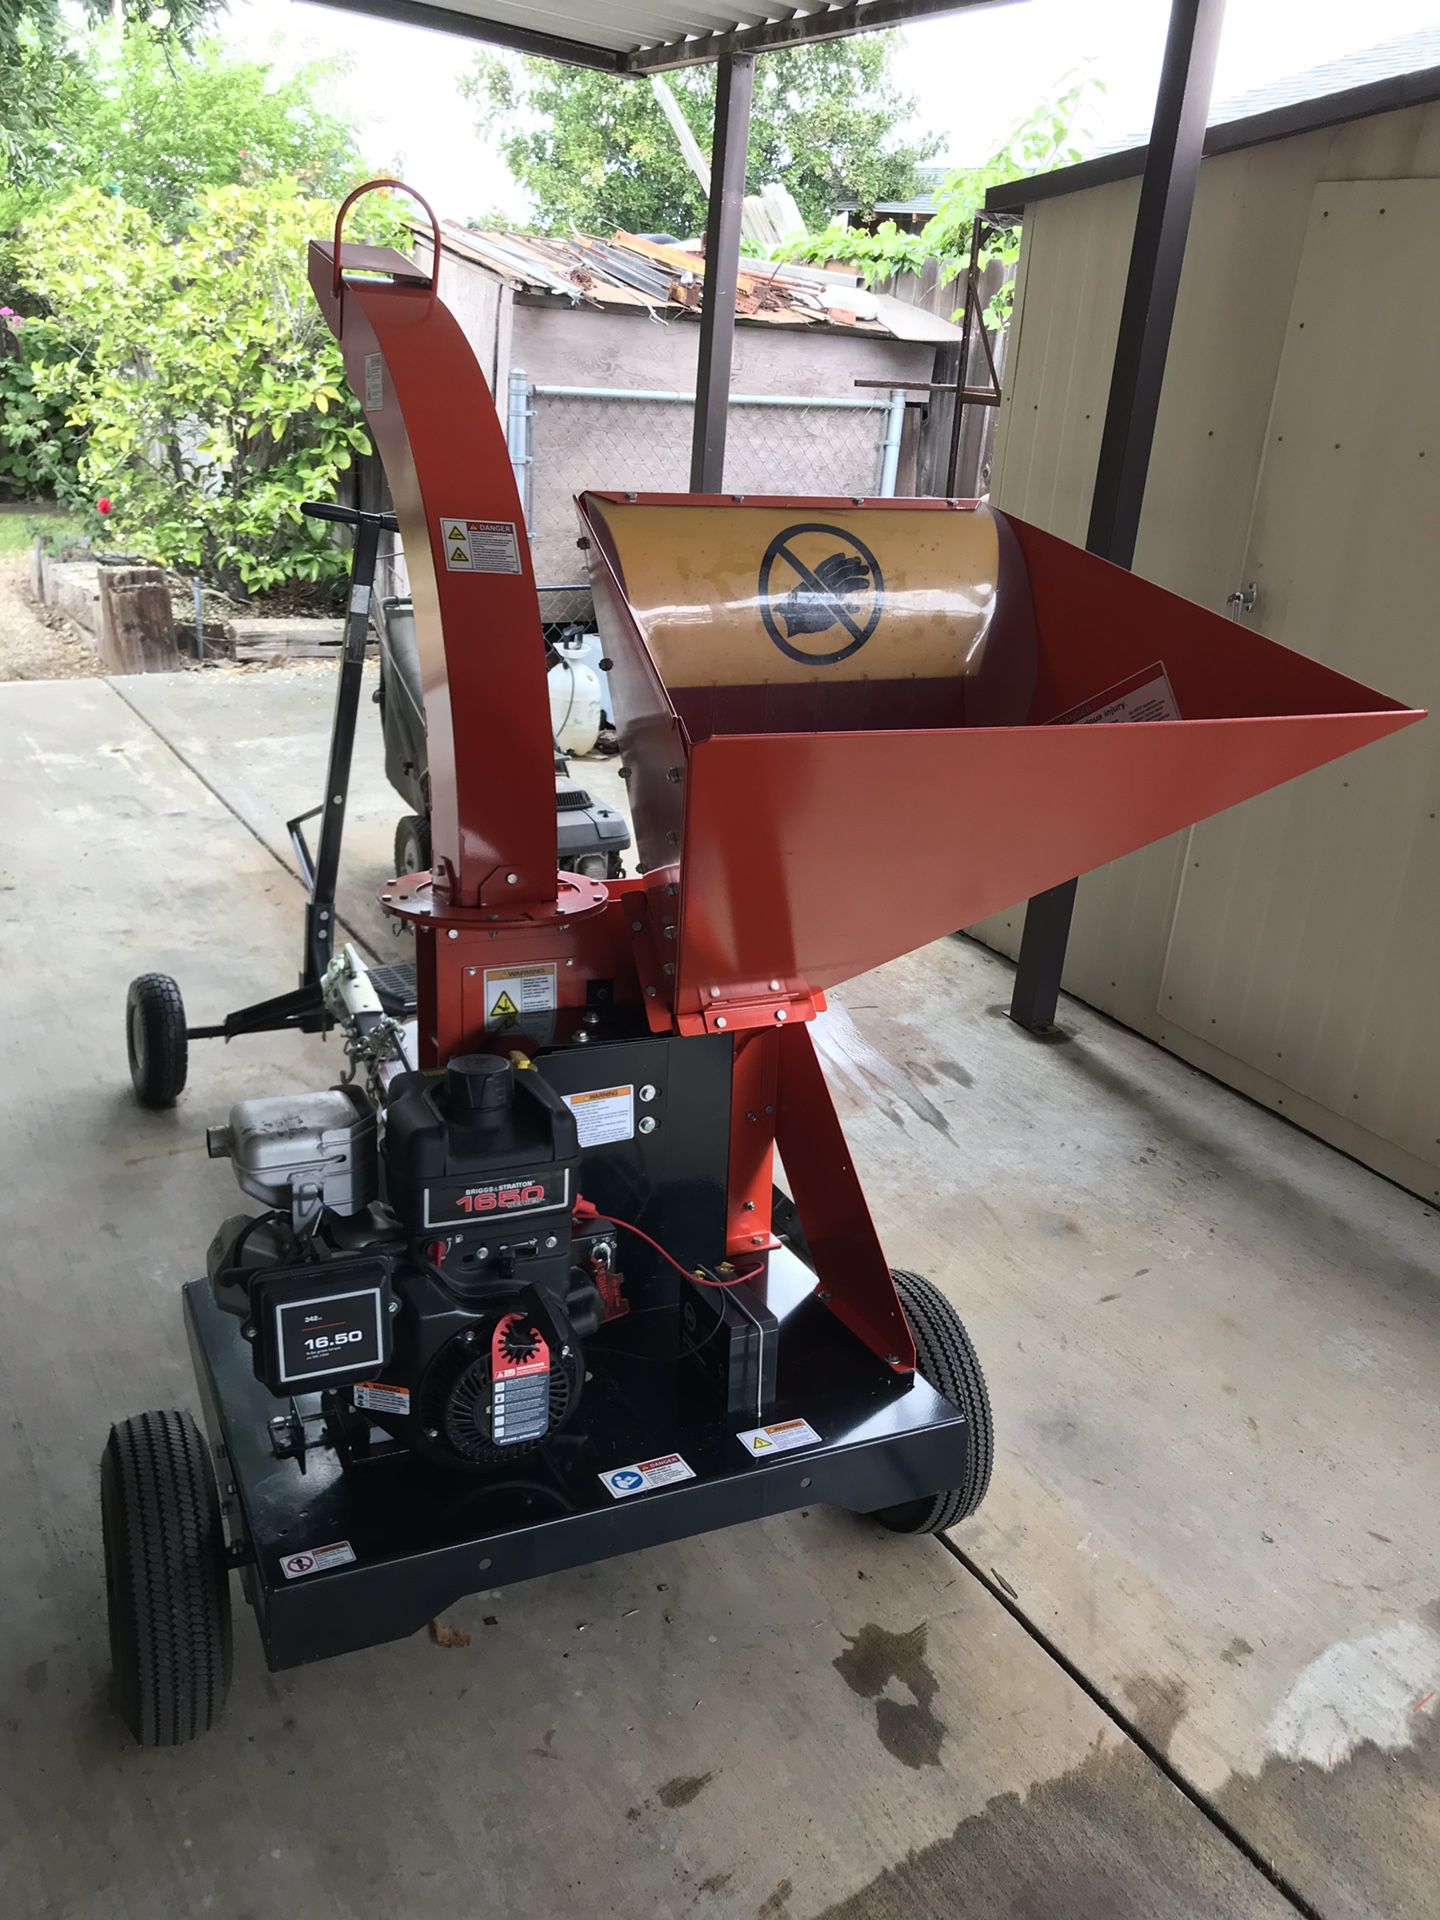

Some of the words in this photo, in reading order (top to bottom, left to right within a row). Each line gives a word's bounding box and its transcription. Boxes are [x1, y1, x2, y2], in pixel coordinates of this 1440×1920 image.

[480, 524, 511, 532] DANGER
[508, 968, 545, 977] WARNING
[589, 1090, 618, 1099] WARNING
[456, 1185, 545, 1213] 1650
[304, 1330, 363, 1349] 16.50
[650, 1456, 679, 1468] DANGER
